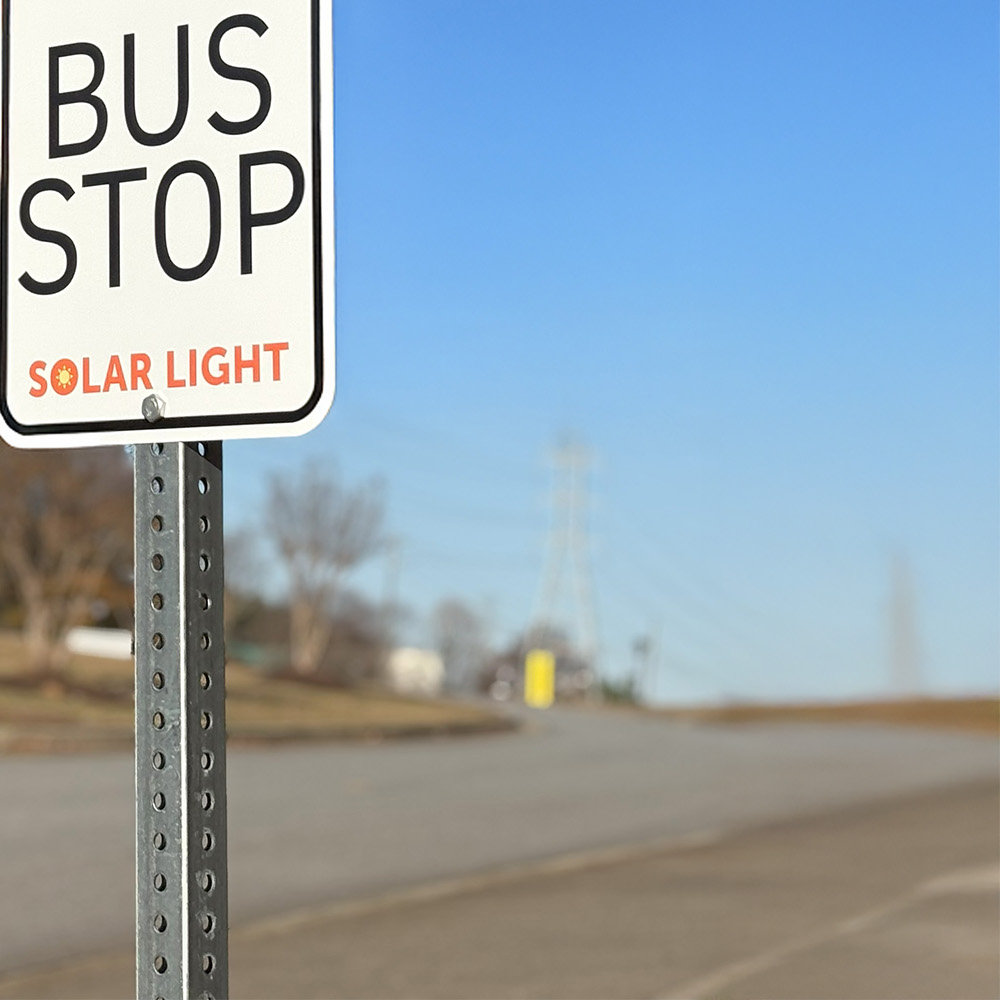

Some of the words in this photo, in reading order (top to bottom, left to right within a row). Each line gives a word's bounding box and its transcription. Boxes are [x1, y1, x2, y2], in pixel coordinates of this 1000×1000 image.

[48, 13, 273, 160] BUS
[17, 149, 306, 296] STOP
[28, 352, 153, 399] SOLAR
[166, 342, 290, 388] LIGHT
